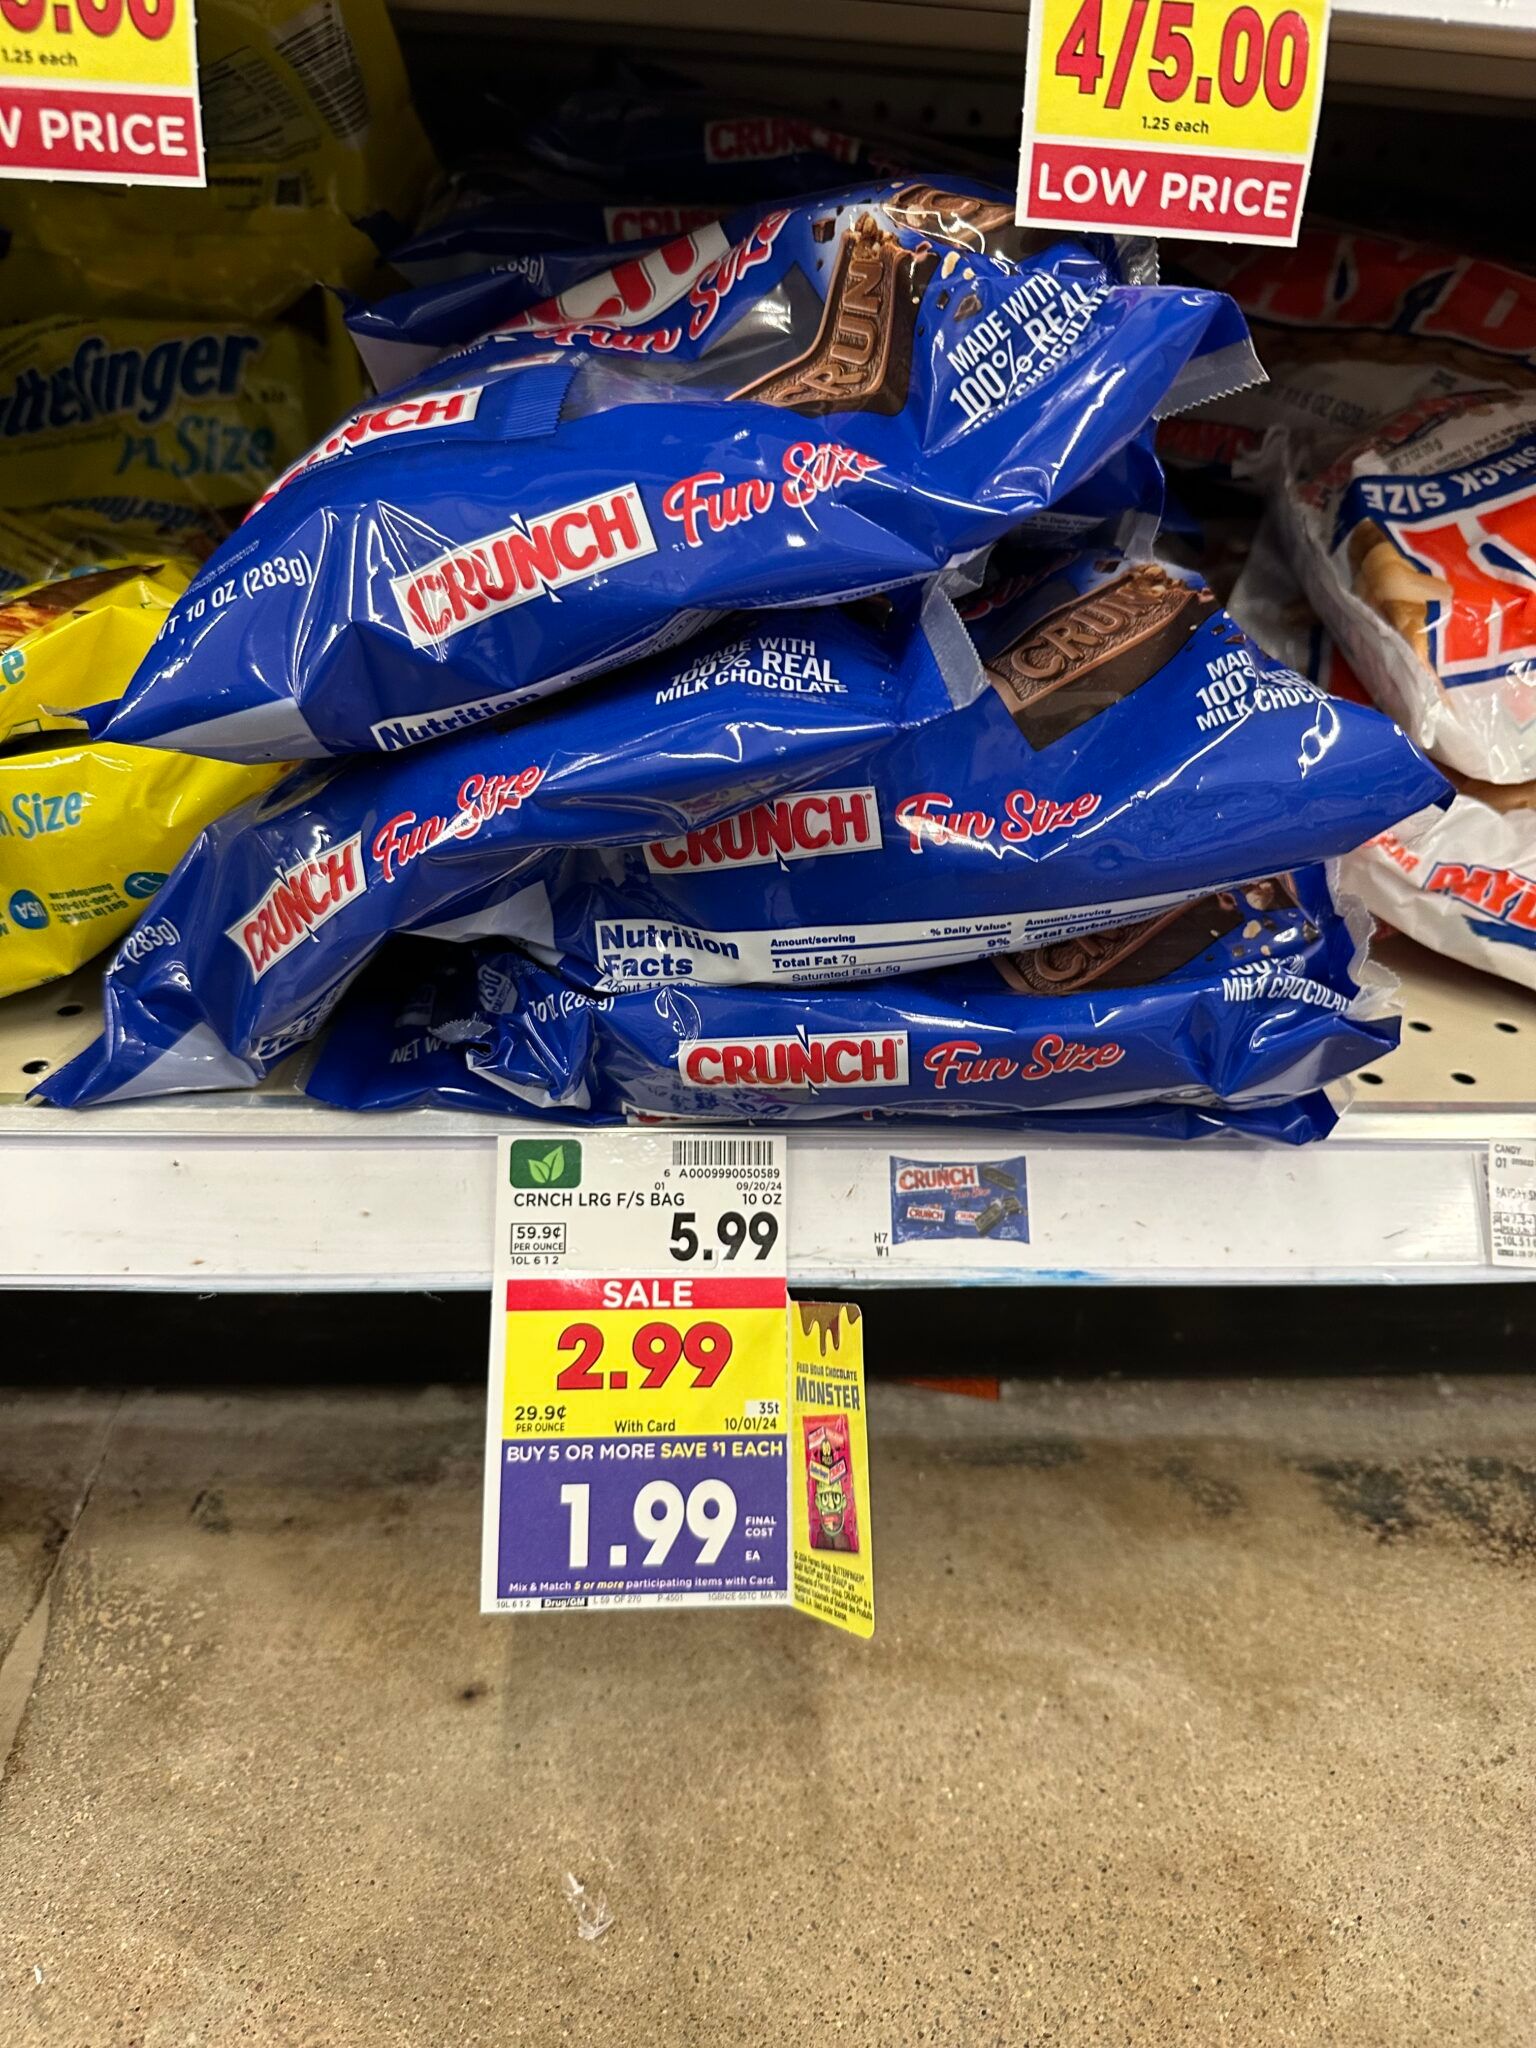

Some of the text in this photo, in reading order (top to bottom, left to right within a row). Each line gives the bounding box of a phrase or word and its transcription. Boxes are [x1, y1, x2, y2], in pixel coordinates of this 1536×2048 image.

[2, 48, 79, 67] 1.25 each
[1055, 0, 1310, 112] 4/5.00
[38, 107, 189, 157] PRICE
[1141, 115, 1210, 135] 1.25 each
[1038, 161, 1293, 220] LOW PRICE
[946, 271, 1063, 378] MADE WITH
[1360, 482, 1448, 515] SIZE
[406, 441, 888, 636] CRUNCH Fun Size
[186, 597, 206, 623] 10
[211, 578, 238, 609] OZ
[242, 549, 314, 600] (283g)
[691, 636, 816, 670] MADE WITH
[670, 649, 840, 688] 100% REAL
[1205, 649, 1255, 682] MAD
[654, 668, 850, 706] MILK CHOCOLATE
[1195, 695, 1255, 732] MILK
[12, 792, 83, 839] Size
[648, 789, 1102, 870] CRUNCH Fun Size
[242, 840, 358, 973] CRUNCH
[372, 810, 447, 884] Fun
[15, 903, 47, 919] USA
[1025, 907, 1113, 927] Amount/serving
[124, 915, 181, 965] (283g)
[600, 923, 740, 960] Nutrition
[770, 934, 857, 948] Amount/serving
[930, 927, 942, 937] %
[943, 925, 972, 937] Daily
[1024, 926, 1064, 943] Total
[772, 937, 1011, 969] Total Fat 7g 9%
[602, 952, 694, 978] Facts
[792, 964, 901, 982] Saturated Fat 4.5g
[390, 1037, 421, 1064] NET
[685, 1032, 1127, 1090] CRUNCH Fun Size
[1494, 1143, 1522, 1155] CANDY
[663, 1168, 781, 1179] 6 A0009990050589
[1495, 1157, 1507, 1168] 01
[654, 1180, 783, 1192] 01 09/20/24
[899, 1167, 976, 1190] CRUNCH
[513, 1190, 782, 1210] CRNCH LRG F/S BAG 10 OZ
[908, 1207, 944, 1220] CRUNCH
[516, 1225, 562, 1240] 59.9¢
[669, 1210, 779, 1262] 5.99
[873, 1232, 888, 1244] H7
[514, 1241, 564, 1251] PER OUNCE
[875, 1246, 890, 1257] W1
[510, 1255, 560, 1265] 10L 6 1 2
[602, 1279, 694, 1308] SALE
[556, 1320, 733, 1391] 2.99
[825, 1365, 858, 1382] CHOCOLATE
[796, 1376, 861, 1411] MONSTER
[514, 1402, 780, 1422] 29.9¢ 35t
[515, 1417, 778, 1434] PER OUNCE With Card 10/01/24
[506, 1440, 783, 1462] BUY 5 OR MORE SAVE $1 EACH
[560, 1478, 738, 1568] 1.99
[745, 1515, 777, 1526] FINAL
[745, 1527, 774, 1538] COST
[745, 1550, 760, 1561] EA
[509, 1574, 777, 1593] Mix & Match 5 or more participating items with Card.
[512, 1599, 517, 1608] 6
[525, 1599, 531, 1608] 2
[543, 1597, 586, 1608] Drug/GM
[613, 1594, 626, 1604] OF
